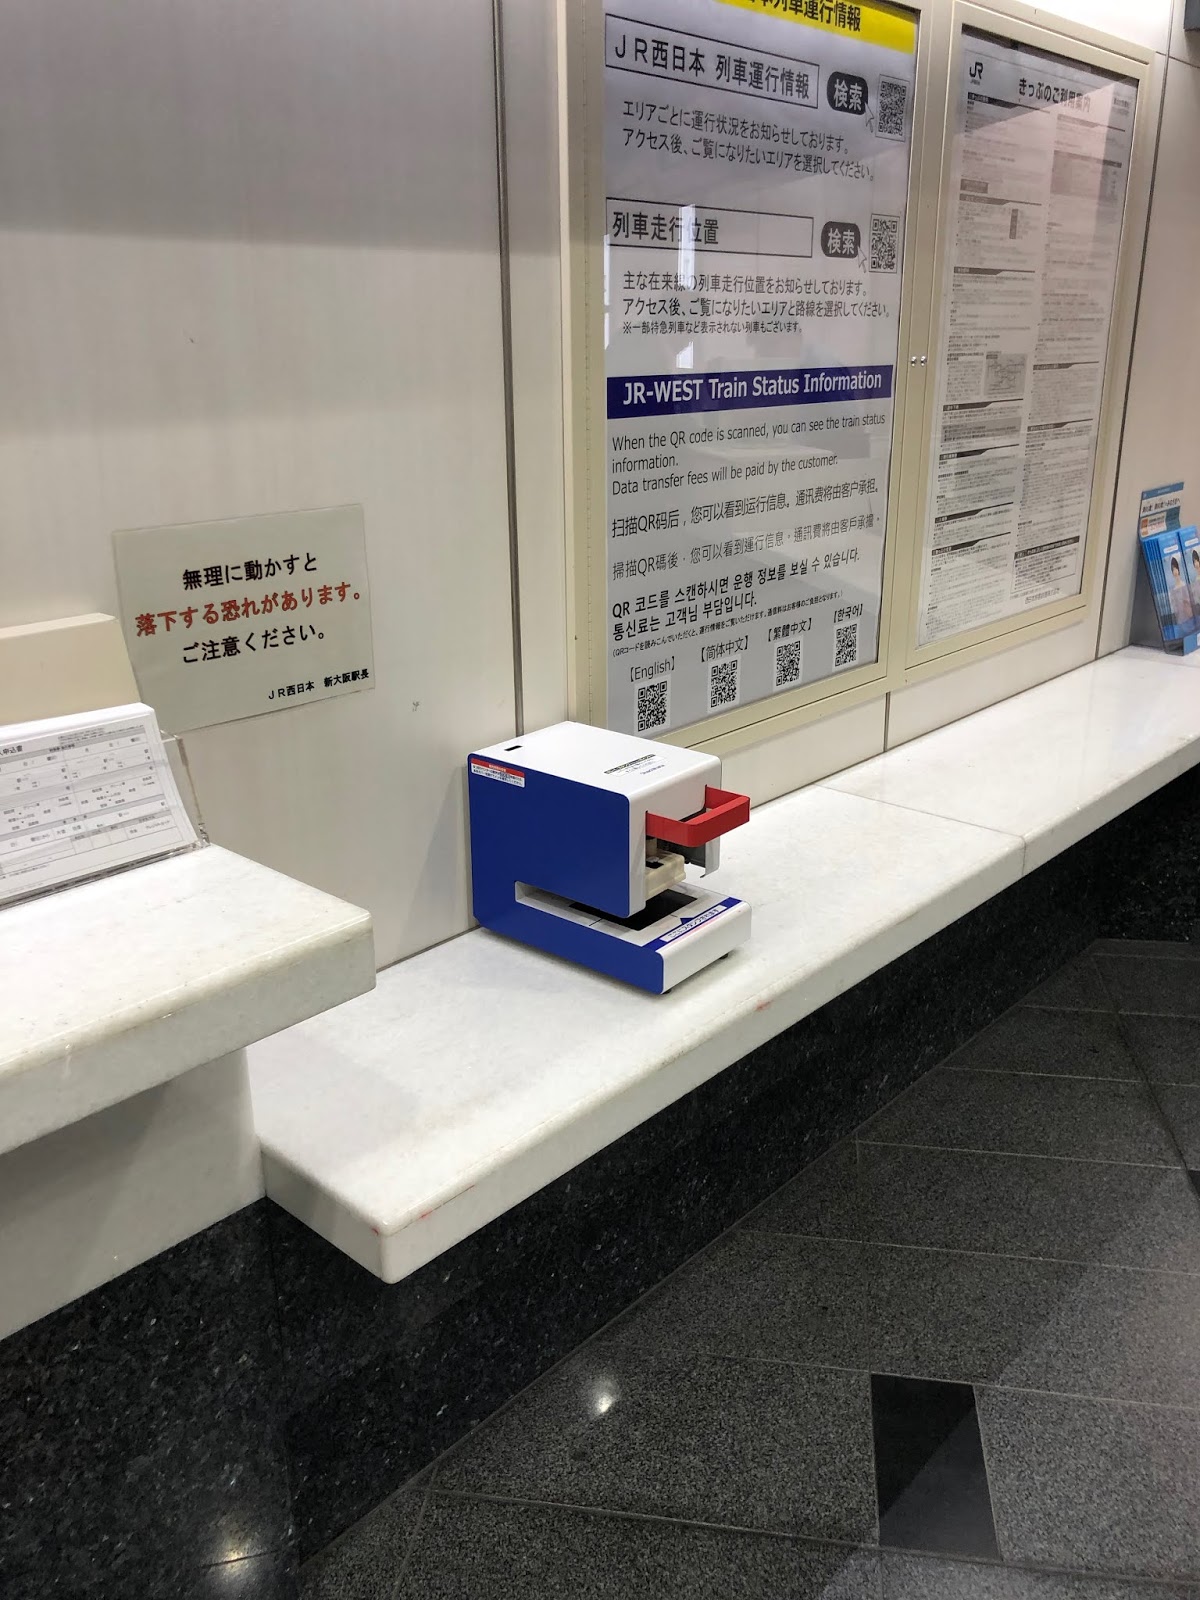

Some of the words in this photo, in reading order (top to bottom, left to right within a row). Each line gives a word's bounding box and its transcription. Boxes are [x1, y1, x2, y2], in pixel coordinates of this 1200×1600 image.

[615, 34, 705, 77] JR西日本
[715, 53, 810, 100] 列車運行情報
[969, 61, 984, 79] JR
[833, 79, 863, 111] 検索
[622, 100, 848, 154] エリアごとに運行状況をお知らせしております。
[622, 128, 874, 181] アクセス後、ご覧になりたいエリアを選択してください。
[827, 228, 855, 255] 検索
[622, 298, 889, 319] アクセス後、ご覧になりたいエリアと路線を選択してください。
[623, 379, 704, 405] JR-WEST
[709, 377, 747, 399] Train
[752, 374, 799, 396] Status
[804, 371, 882, 393] Information
[612, 436, 645, 452] When
[648, 433, 666, 448] the
[670, 431, 686, 447] QR
[689, 428, 713, 444] code
[716, 428, 725, 441] is
[727, 424, 769, 440] scanned,
[772, 423, 788, 439] you
[791, 421, 806, 434] can
[809, 419, 824, 431] see
[826, 417, 840, 430] the
[842, 415, 860, 428] train
[862, 413, 885, 426] status
[612, 454, 679, 474] information.
[612, 480, 639, 496] Data
[642, 473, 684, 492] transfer
[687, 469, 709, 486] fees
[711, 467, 728, 481] will
[730, 464, 742, 479] be
[745, 461, 765, 479] paid
[767, 460, 779, 476] by
[781, 458, 796, 473] the
[798, 454, 838, 470] customer.
[182, 552, 318, 591] 無理に動かすと
[612, 602, 630, 619] QR
[635, 589, 670, 613] 코드를
[674, 576, 729, 603] 스캔하시면
[733, 573, 753, 592] 운행
[757, 565, 786, 586] 정보를
[790, 559, 808, 577] 보실
[811, 557, 820, 573] 수
[823, 547, 860, 570] 있습니다.
[135, 581, 360, 637] 落下する恐れがあります。
[612, 617, 661, 642] 통신료는
[665, 603, 698, 627] 고객님
[702, 591, 757, 618] 부담입니다.
[182, 623, 325, 664] ご注意ください。
[268, 680, 315, 700] JR西日本
[323, 668, 370, 688] 新大阪駅長
